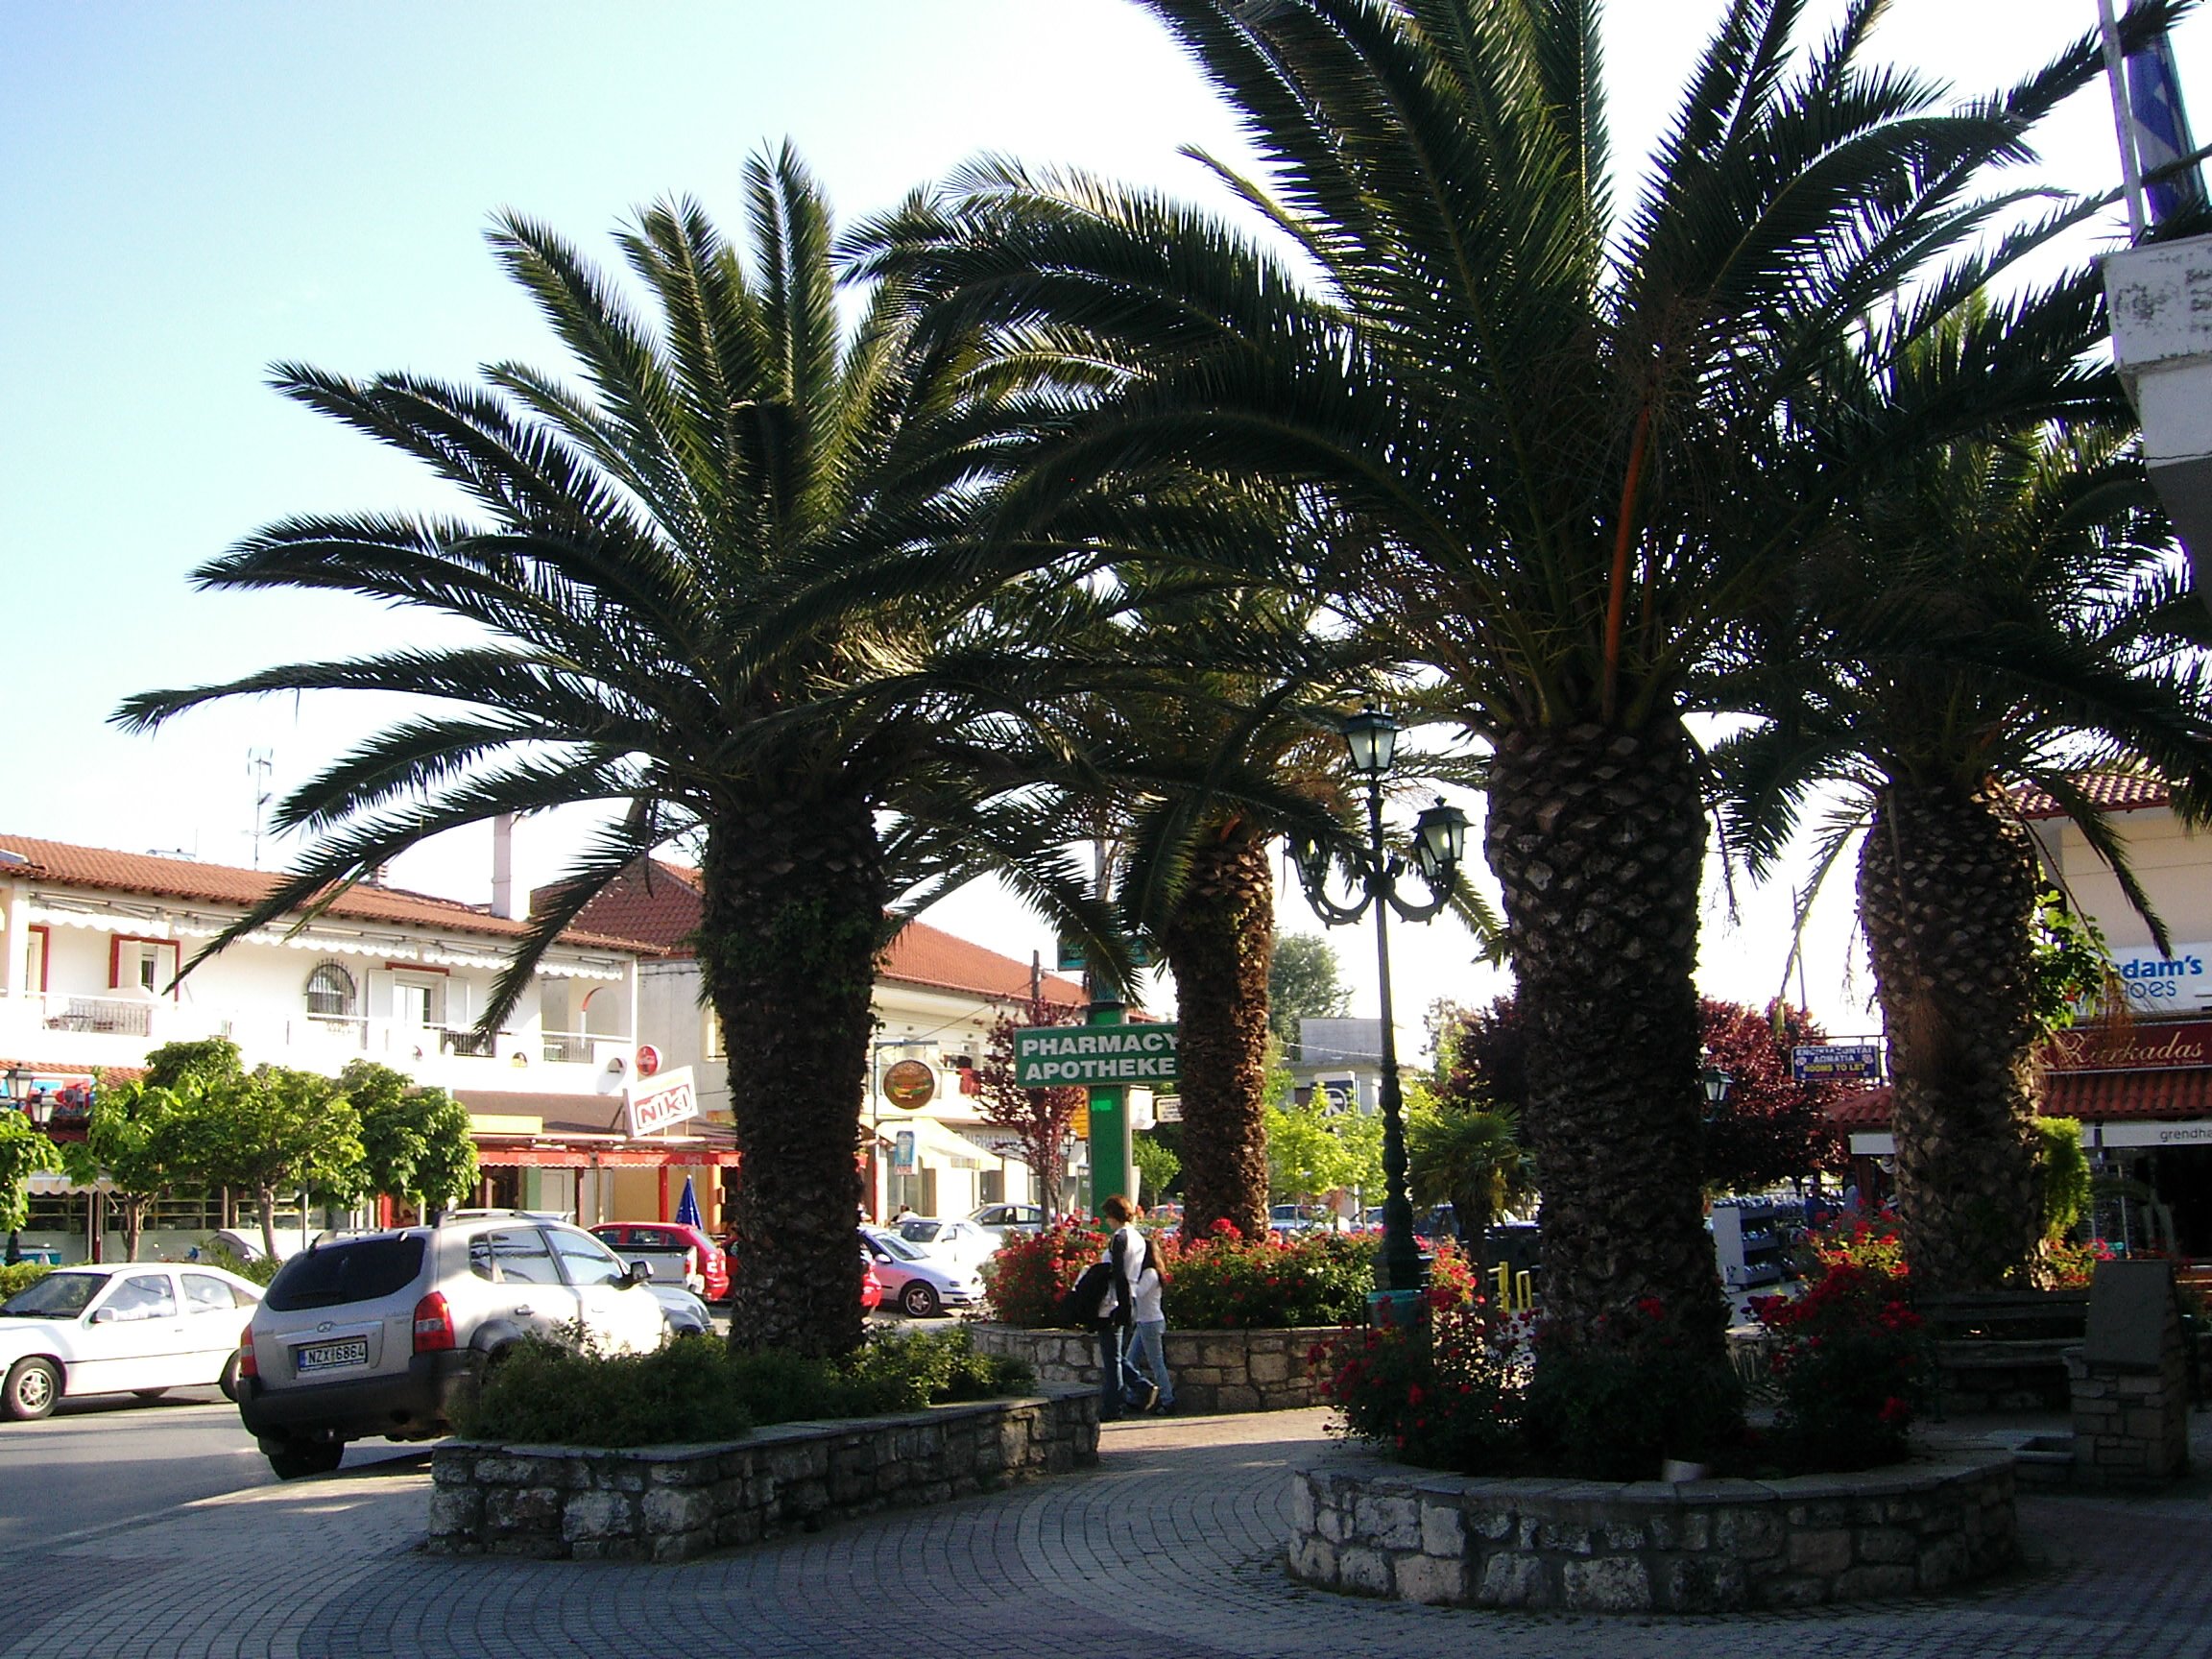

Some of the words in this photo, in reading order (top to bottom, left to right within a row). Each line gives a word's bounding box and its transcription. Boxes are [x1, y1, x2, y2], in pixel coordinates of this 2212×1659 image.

[2116, 955, 2202, 978] dam's
[1022, 1033, 1179, 1057] PHARMACY
[1025, 1057, 1176, 1081] APOTHEKE
[1803, 1064, 1834, 1072] ROOMS
[1849, 1063, 1865, 1071] LET
